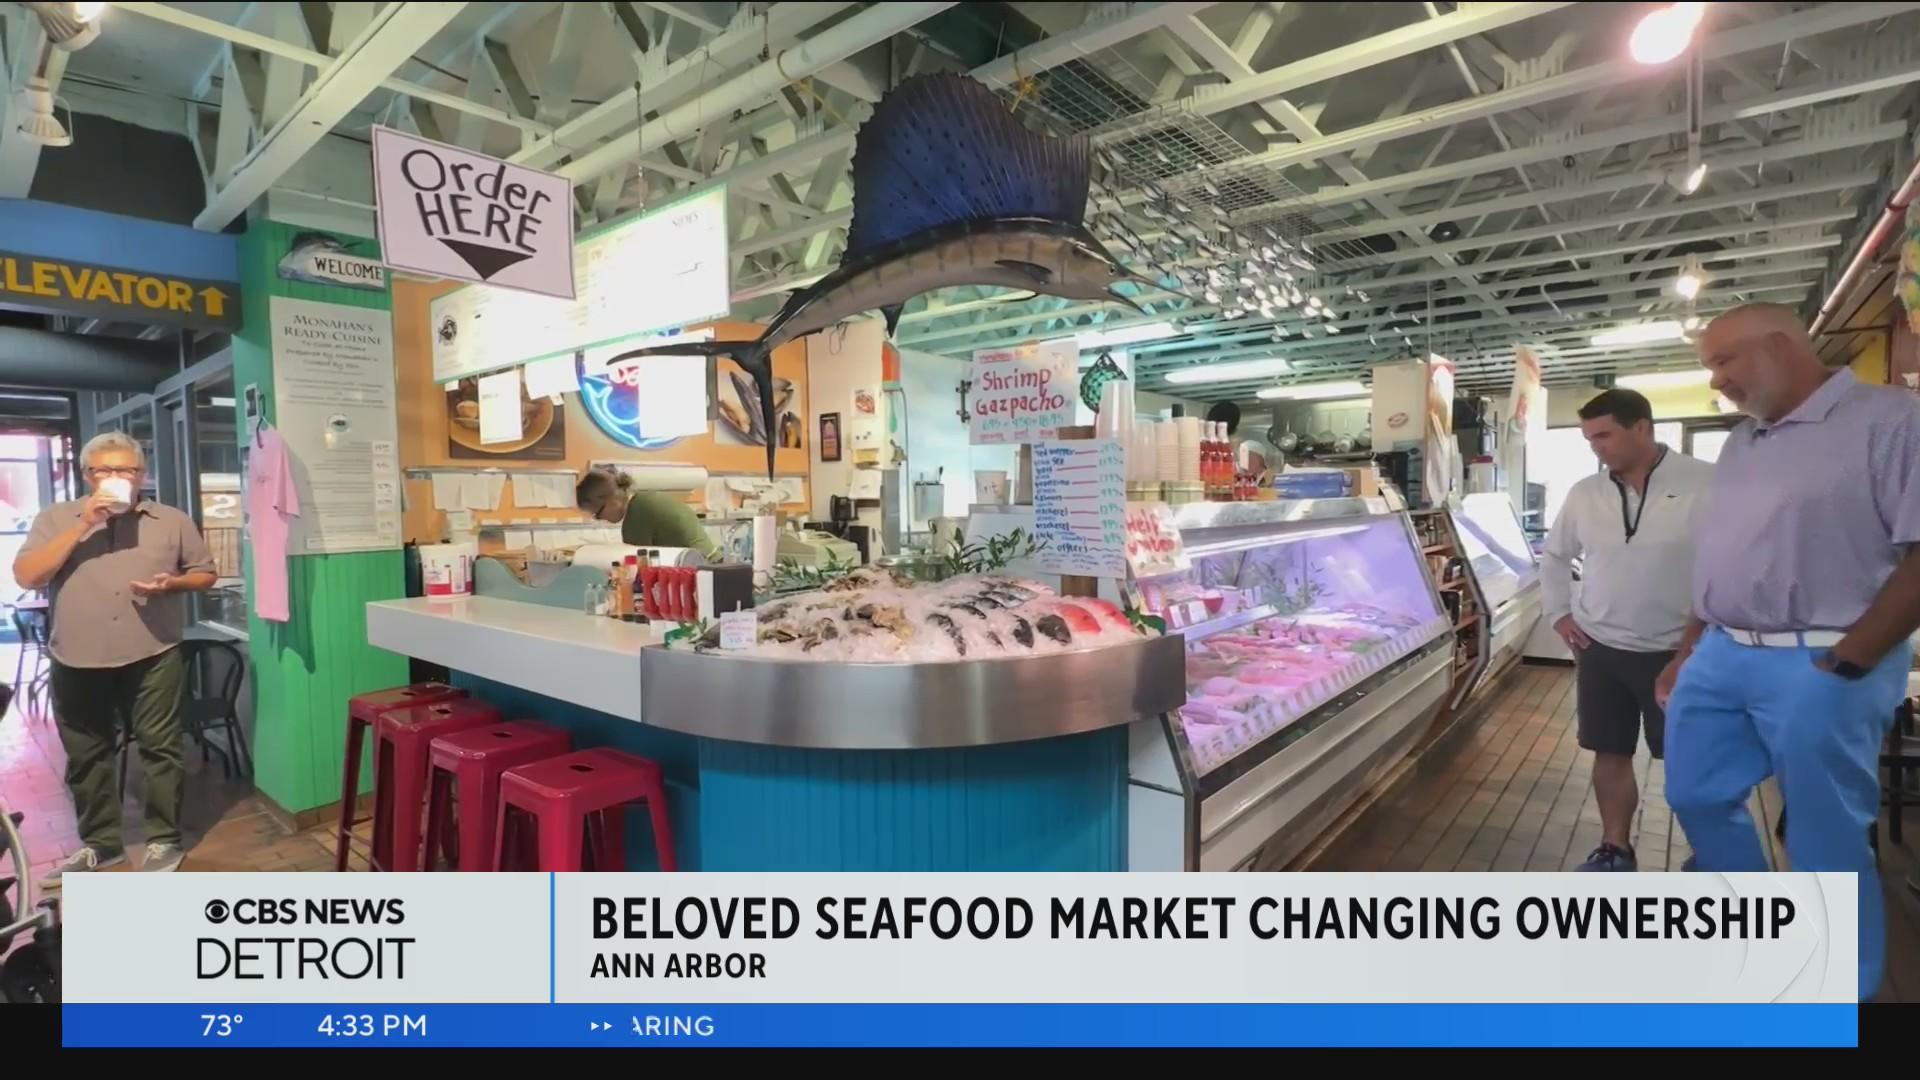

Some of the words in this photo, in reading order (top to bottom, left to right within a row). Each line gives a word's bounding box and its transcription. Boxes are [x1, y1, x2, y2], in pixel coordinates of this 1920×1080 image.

[401, 149, 551, 214] Order
[415, 192, 542, 253] HERE
[0, 256, 193, 312] LEVATOR
[314, 256, 383, 280] WELCOME
[976, 388, 1065, 419] Gazpacho
[982, 367, 1052, 397] Shrimp
